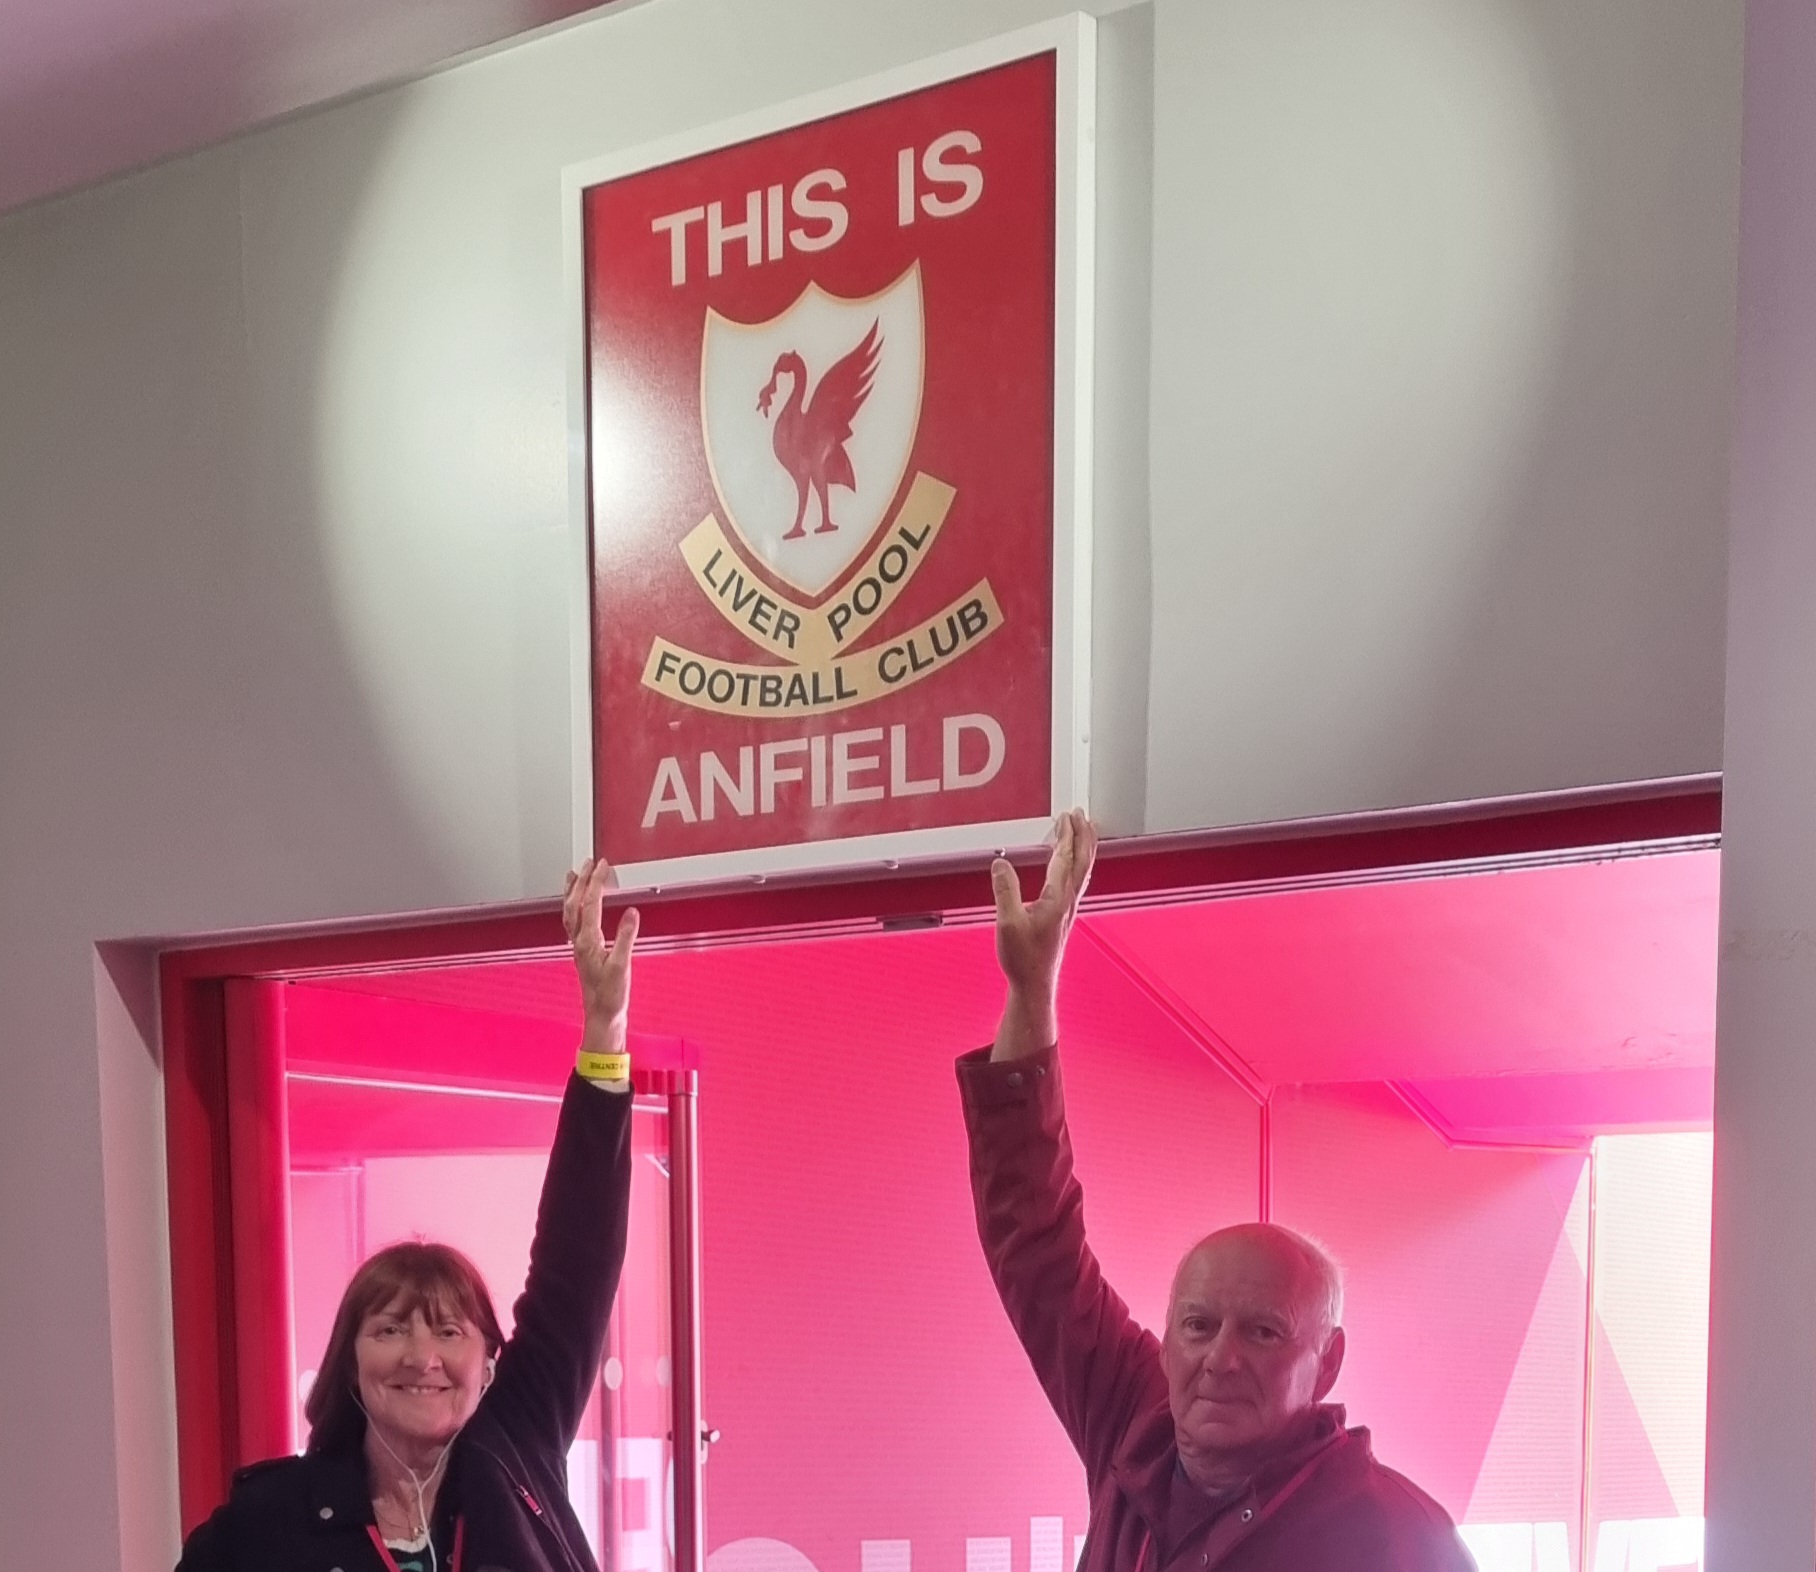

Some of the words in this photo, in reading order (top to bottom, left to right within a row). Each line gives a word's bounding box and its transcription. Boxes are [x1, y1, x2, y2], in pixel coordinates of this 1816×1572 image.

[651, 167, 849, 287] THIS
[897, 129, 984, 227] IS
[702, 548, 802, 650] LIVER
[826, 523, 932, 644] POOL
[653, 650, 858, 708] FOOTBALL
[877, 598, 989, 685] CLUB
[640, 712, 1006, 829] ANFIELD
